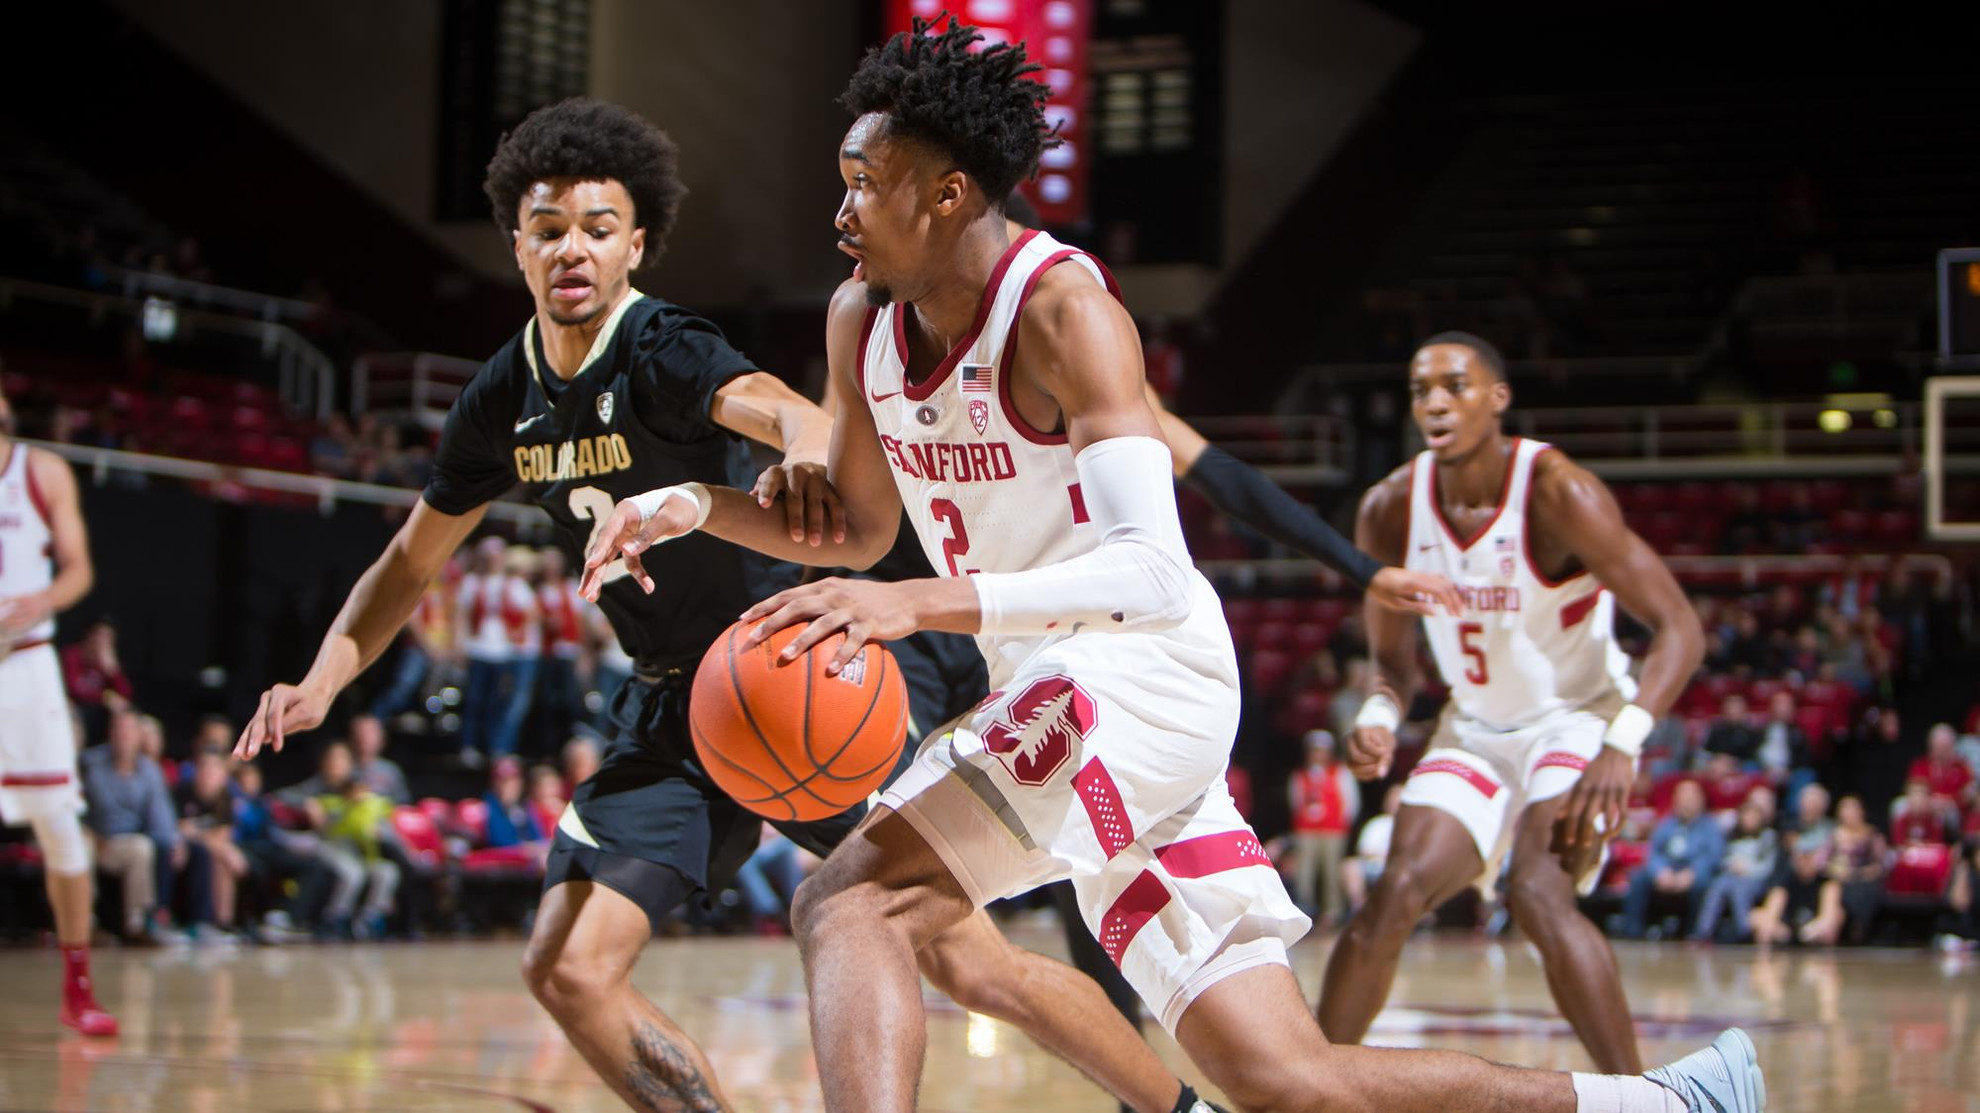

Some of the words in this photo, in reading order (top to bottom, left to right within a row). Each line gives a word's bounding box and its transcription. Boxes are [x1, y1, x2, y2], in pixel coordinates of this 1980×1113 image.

[514, 432, 632, 483] COLORADO
[930, 497, 981, 577] 2
[1458, 621, 1489, 686] 5
